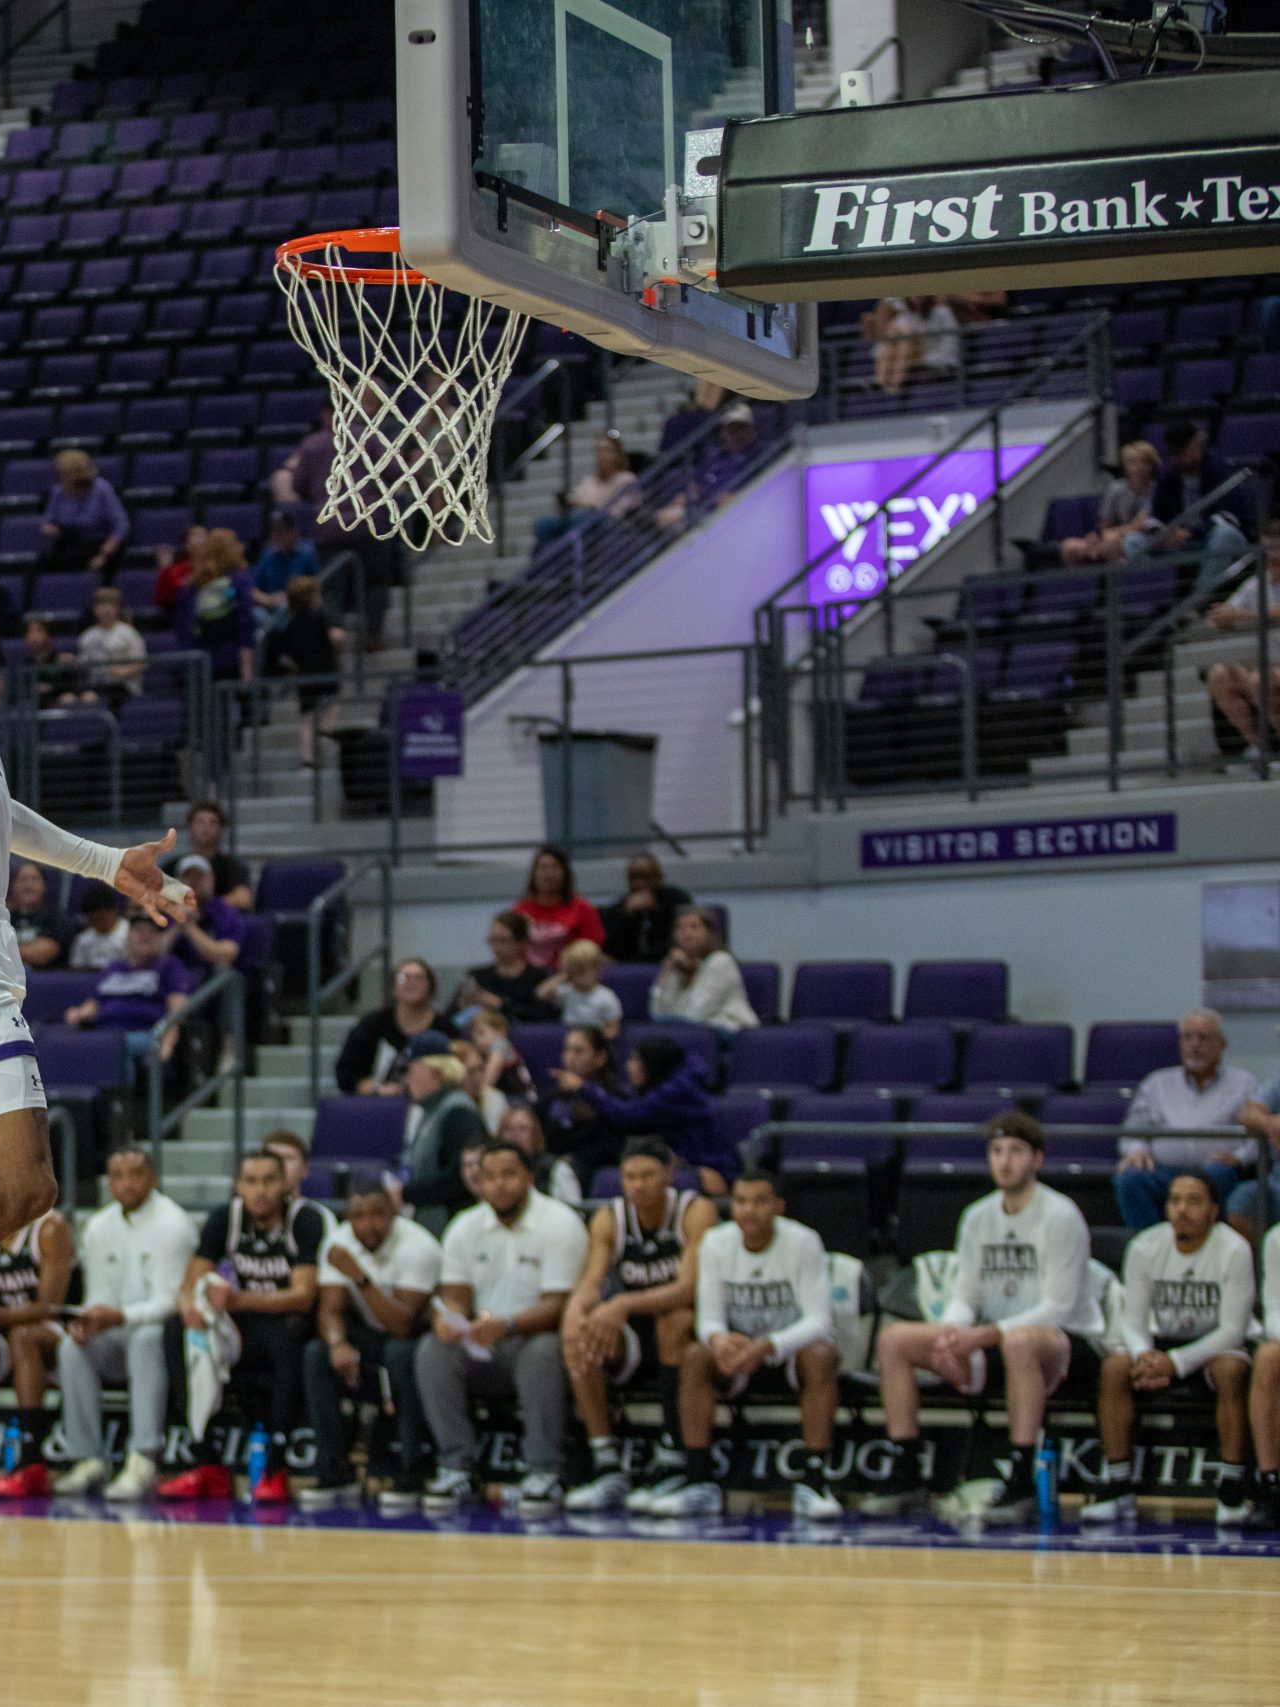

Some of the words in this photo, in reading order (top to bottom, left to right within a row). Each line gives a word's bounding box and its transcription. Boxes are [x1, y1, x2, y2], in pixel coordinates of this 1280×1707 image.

[803, 183, 1004, 254] First
[1019, 180, 1169, 238] Bank
[872, 830, 1000, 863] VISITOR
[1014, 819, 1161, 855] SECTION
[1060, 1437, 1225, 1486] KITH
